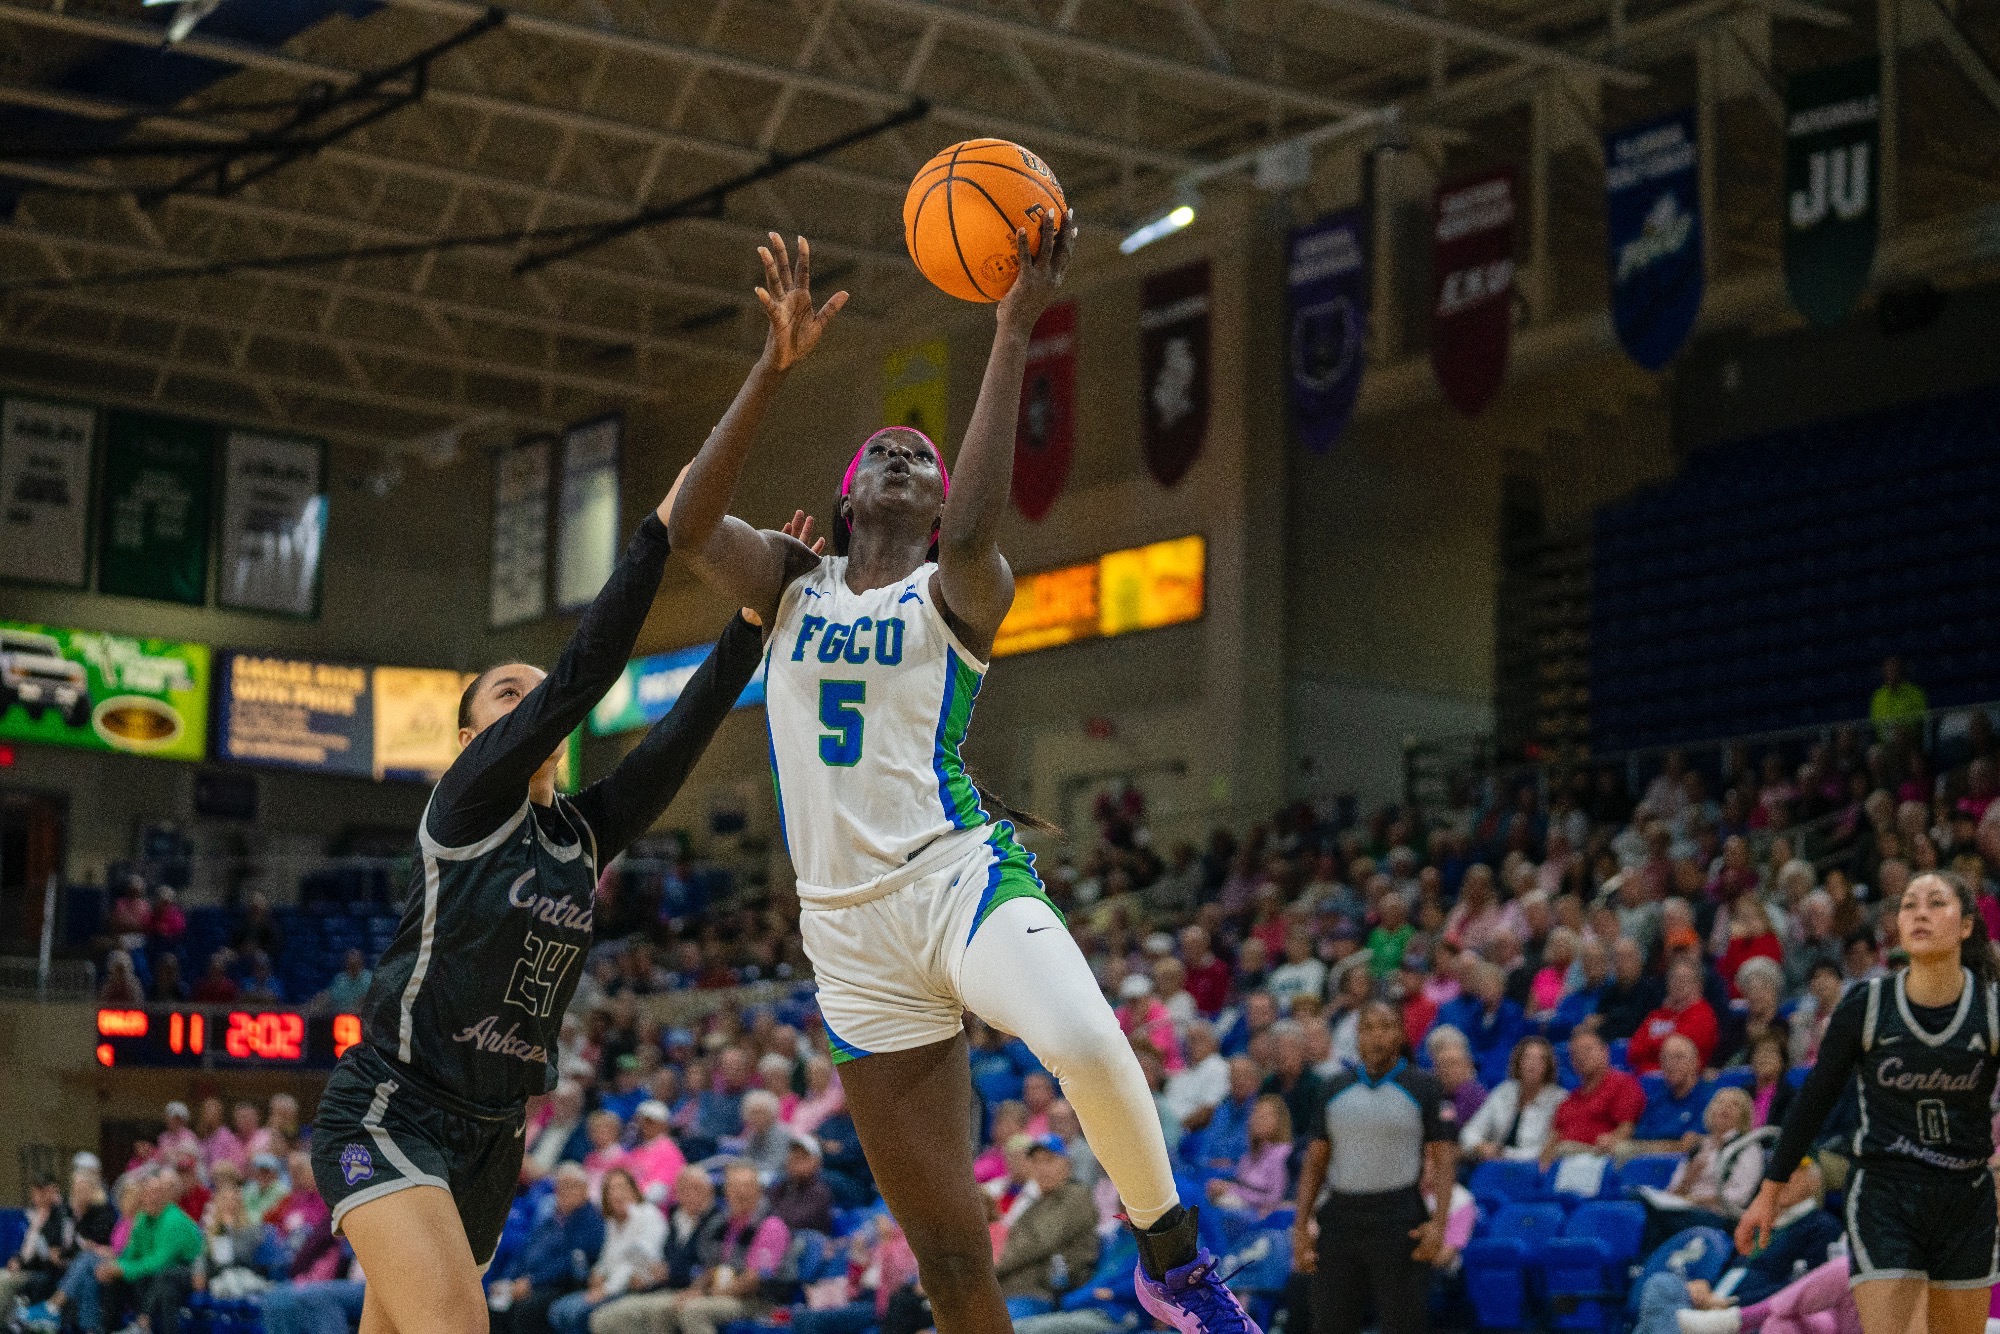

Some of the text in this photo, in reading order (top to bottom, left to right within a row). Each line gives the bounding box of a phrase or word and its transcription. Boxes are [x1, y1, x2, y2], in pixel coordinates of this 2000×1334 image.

[1790, 143, 1868, 227] JU
[791, 613, 906, 666] FGCU
[818, 678, 867, 768] 5
[503, 930, 581, 1018] 24
[169, 1011, 205, 1055] 11
[225, 1011, 305, 1060] 2:02
[1876, 1056, 1985, 1091] Central
[1916, 1098, 1952, 1146] 0
